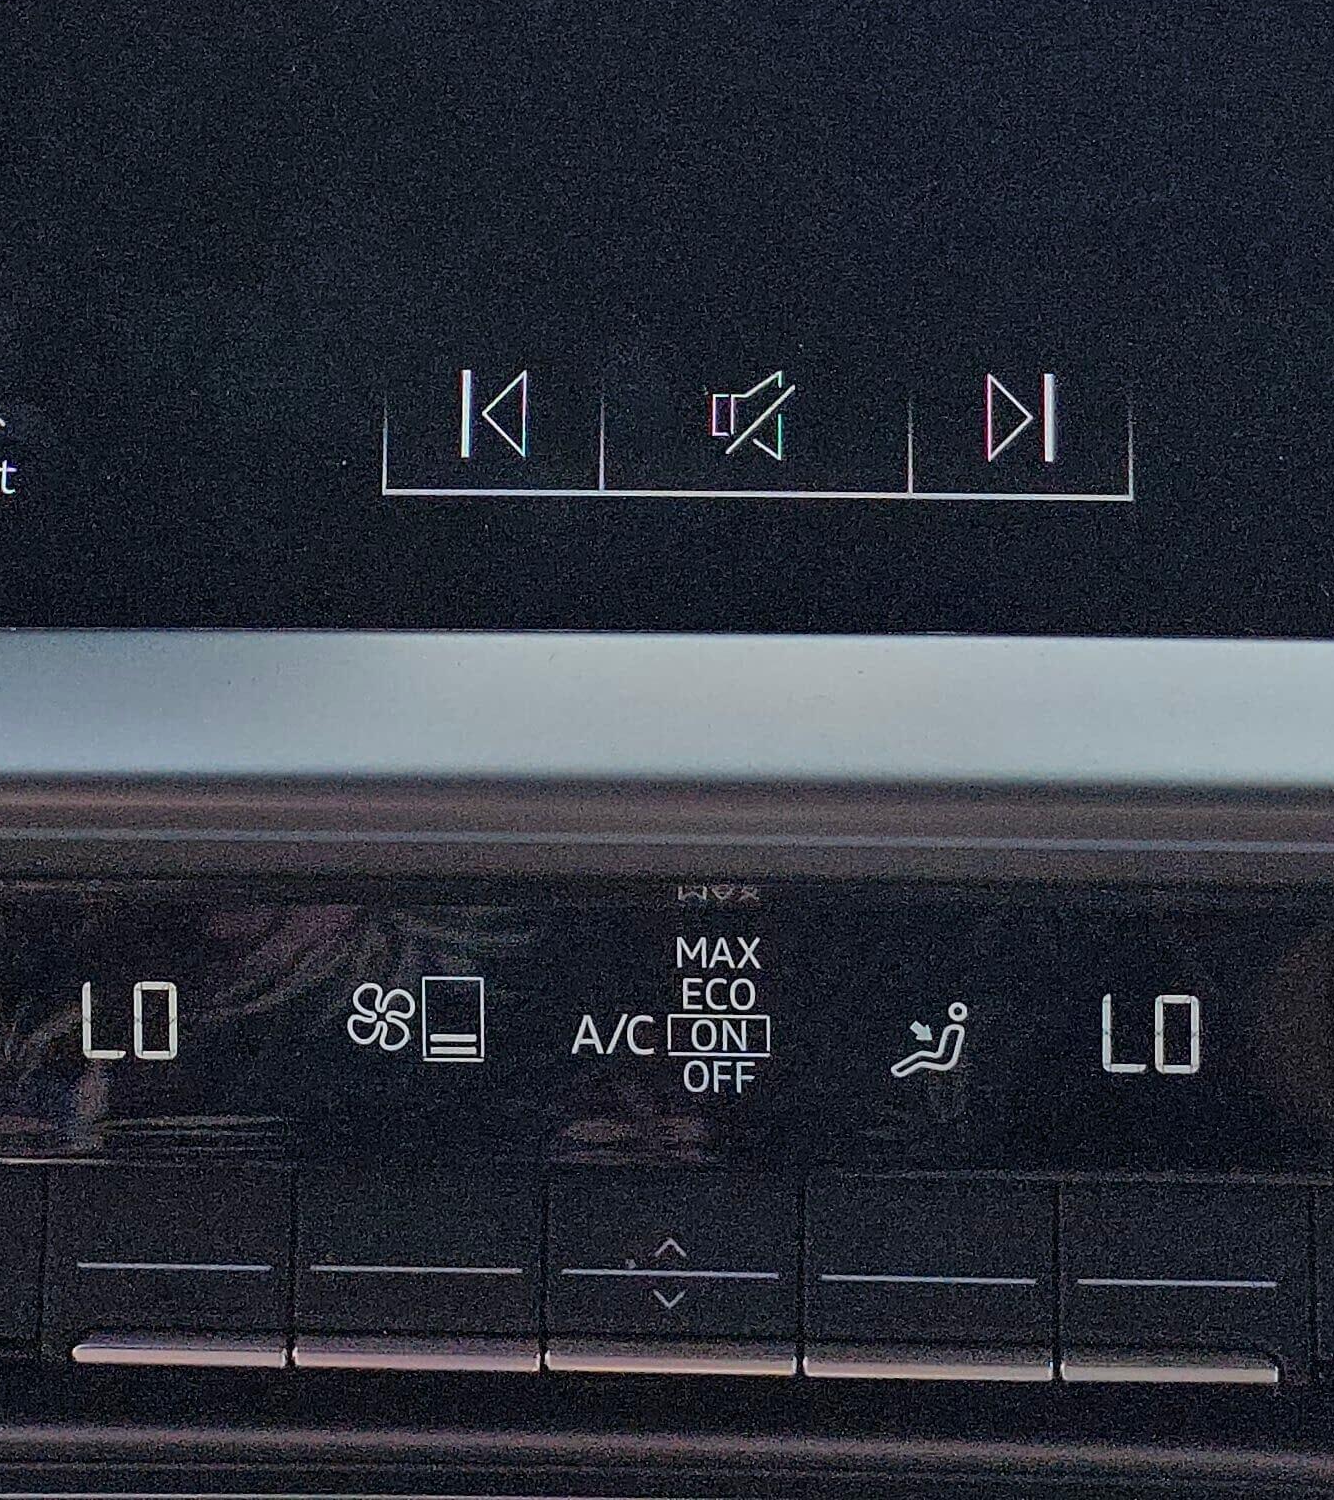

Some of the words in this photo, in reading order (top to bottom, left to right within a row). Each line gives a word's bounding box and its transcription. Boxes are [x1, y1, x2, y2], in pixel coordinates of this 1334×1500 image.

[676, 936, 762, 970] MAX
[682, 977, 757, 1012] ECO
[571, 1014, 656, 1057] A/C
[690, 1019, 748, 1054] ON
[683, 1060, 757, 1094] OFF
